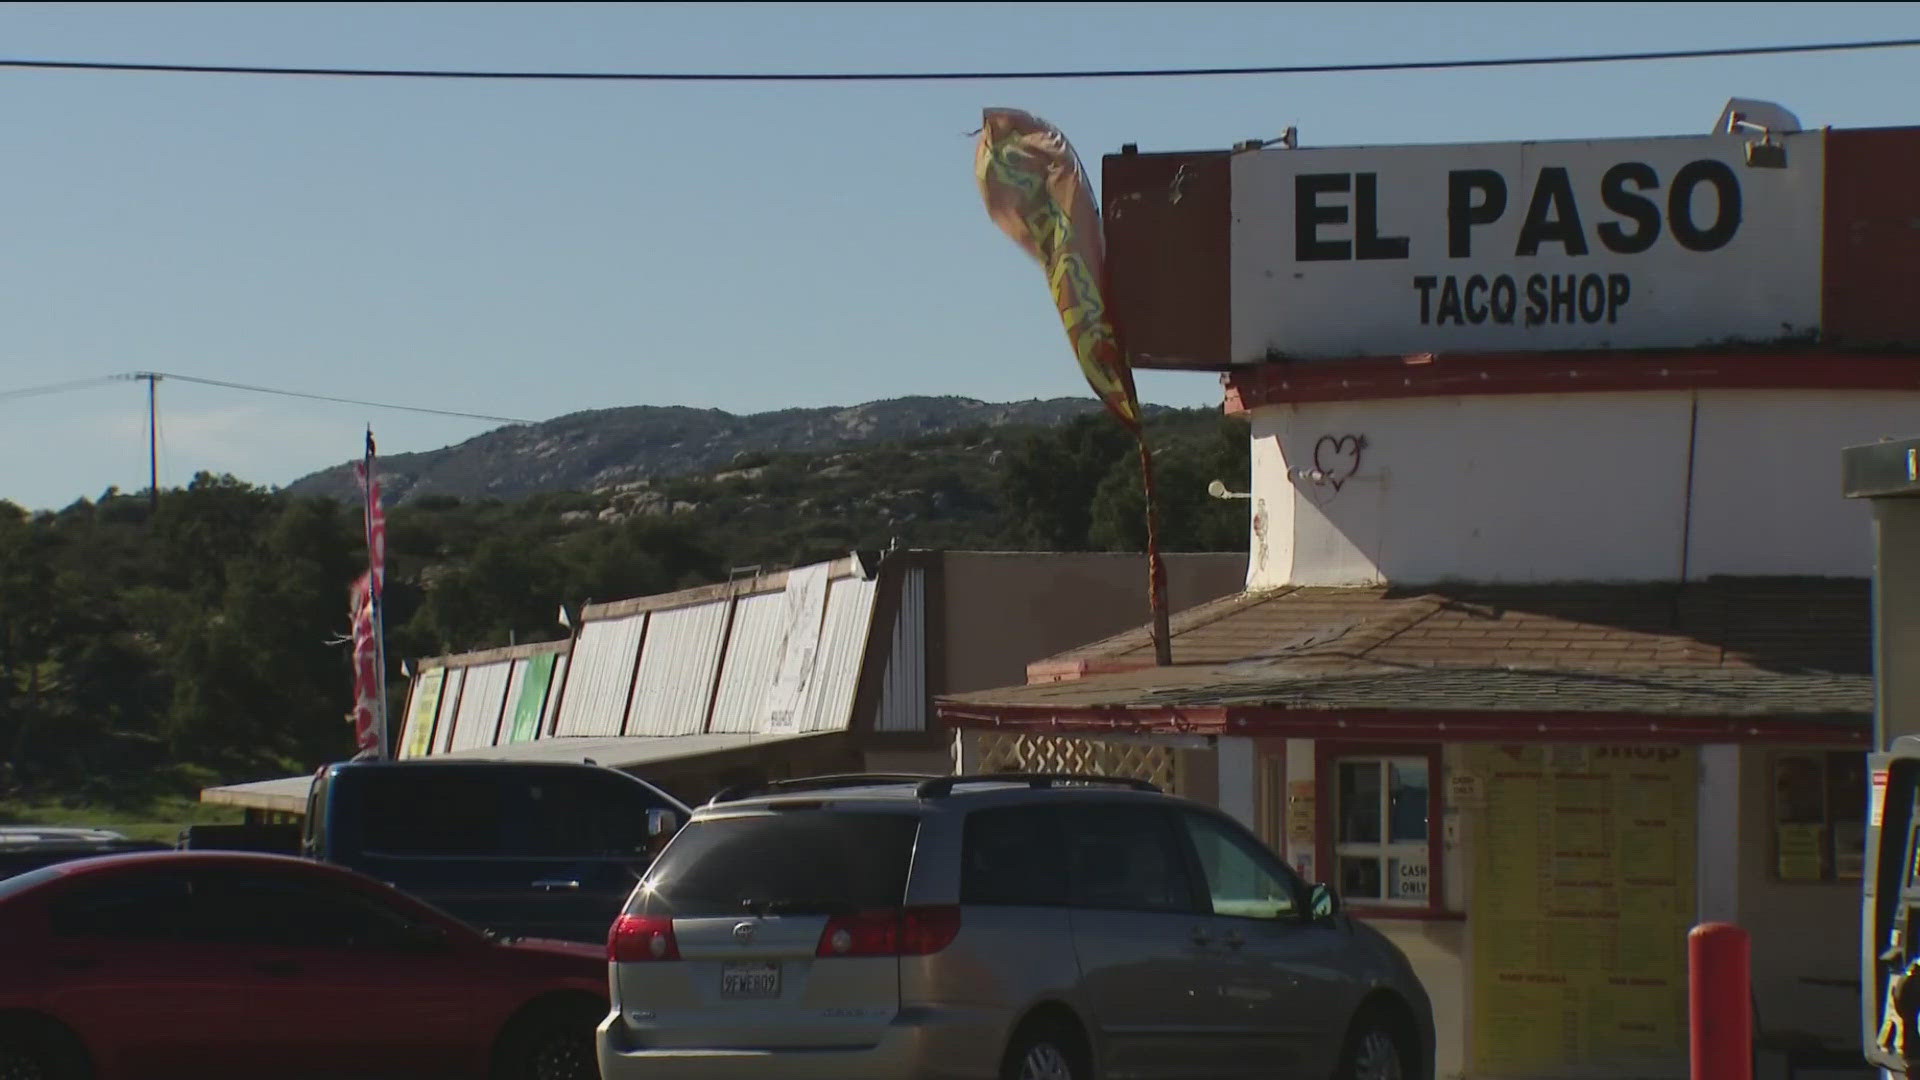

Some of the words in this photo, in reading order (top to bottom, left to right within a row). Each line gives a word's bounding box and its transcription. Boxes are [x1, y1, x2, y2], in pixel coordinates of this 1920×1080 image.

[1295, 172, 1410, 261] EL
[1448, 159, 1743, 258] PASO
[1525, 273, 1631, 326] SHOP
[1401, 865, 1427, 877] CASH
[1401, 881, 1427, 894] ONLY
